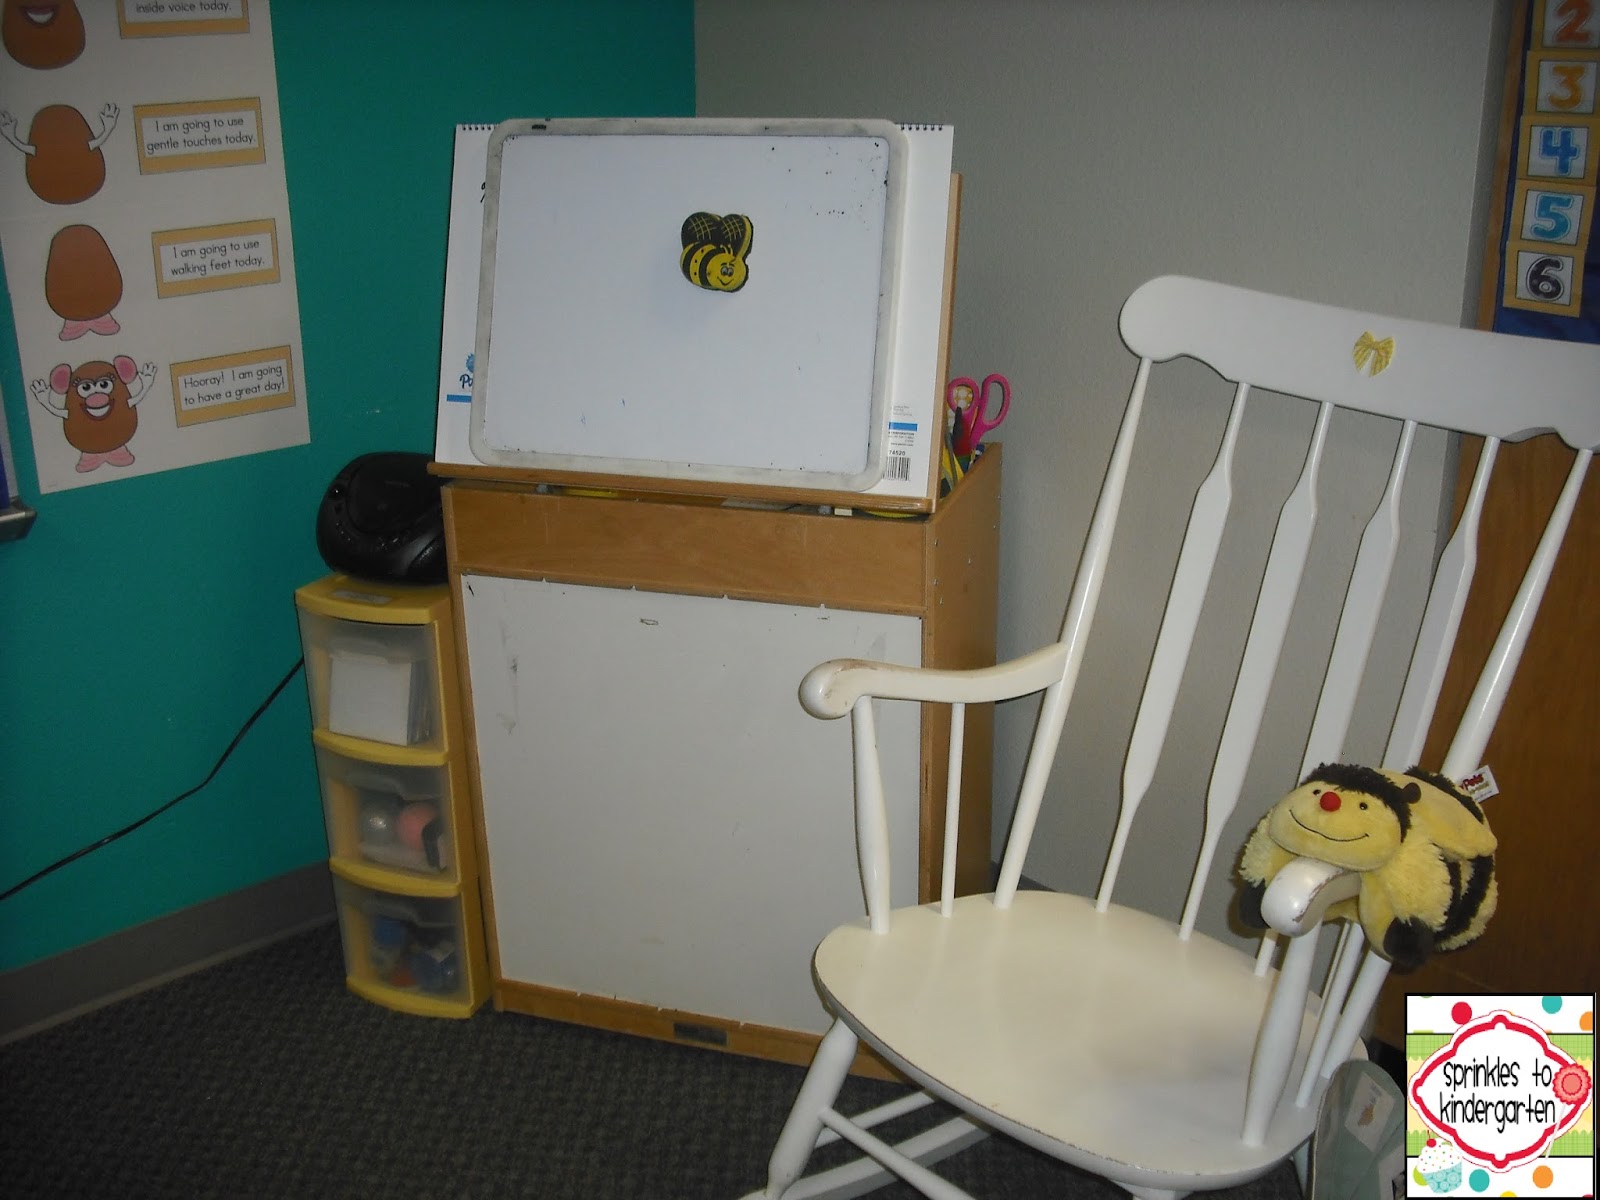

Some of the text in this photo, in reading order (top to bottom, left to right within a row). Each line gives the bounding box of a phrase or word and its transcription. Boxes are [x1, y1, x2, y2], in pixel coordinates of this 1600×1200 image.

[135, 0, 232, 13] inside voice today.
[1554, 0, 1593, 44] 2
[1547, 64, 1586, 109] 3
[155, 118, 244, 134] I am going to use
[147, 132, 256, 155] gentle touches today.
[1539, 127, 1581, 176] 4
[1530, 193, 1574, 242] 5
[180, 249, 196, 258] am
[199, 244, 227, 259] going
[230, 242, 240, 251] to
[243, 240, 260, 249] use
[171, 254, 265, 276] walking feet today.
[1526, 256, 1564, 302] 6
[183, 370, 225, 389] Hooray!
[238, 370, 253, 379] am
[256, 366, 283, 380] going
[184, 377, 285, 405] to have a great day!
